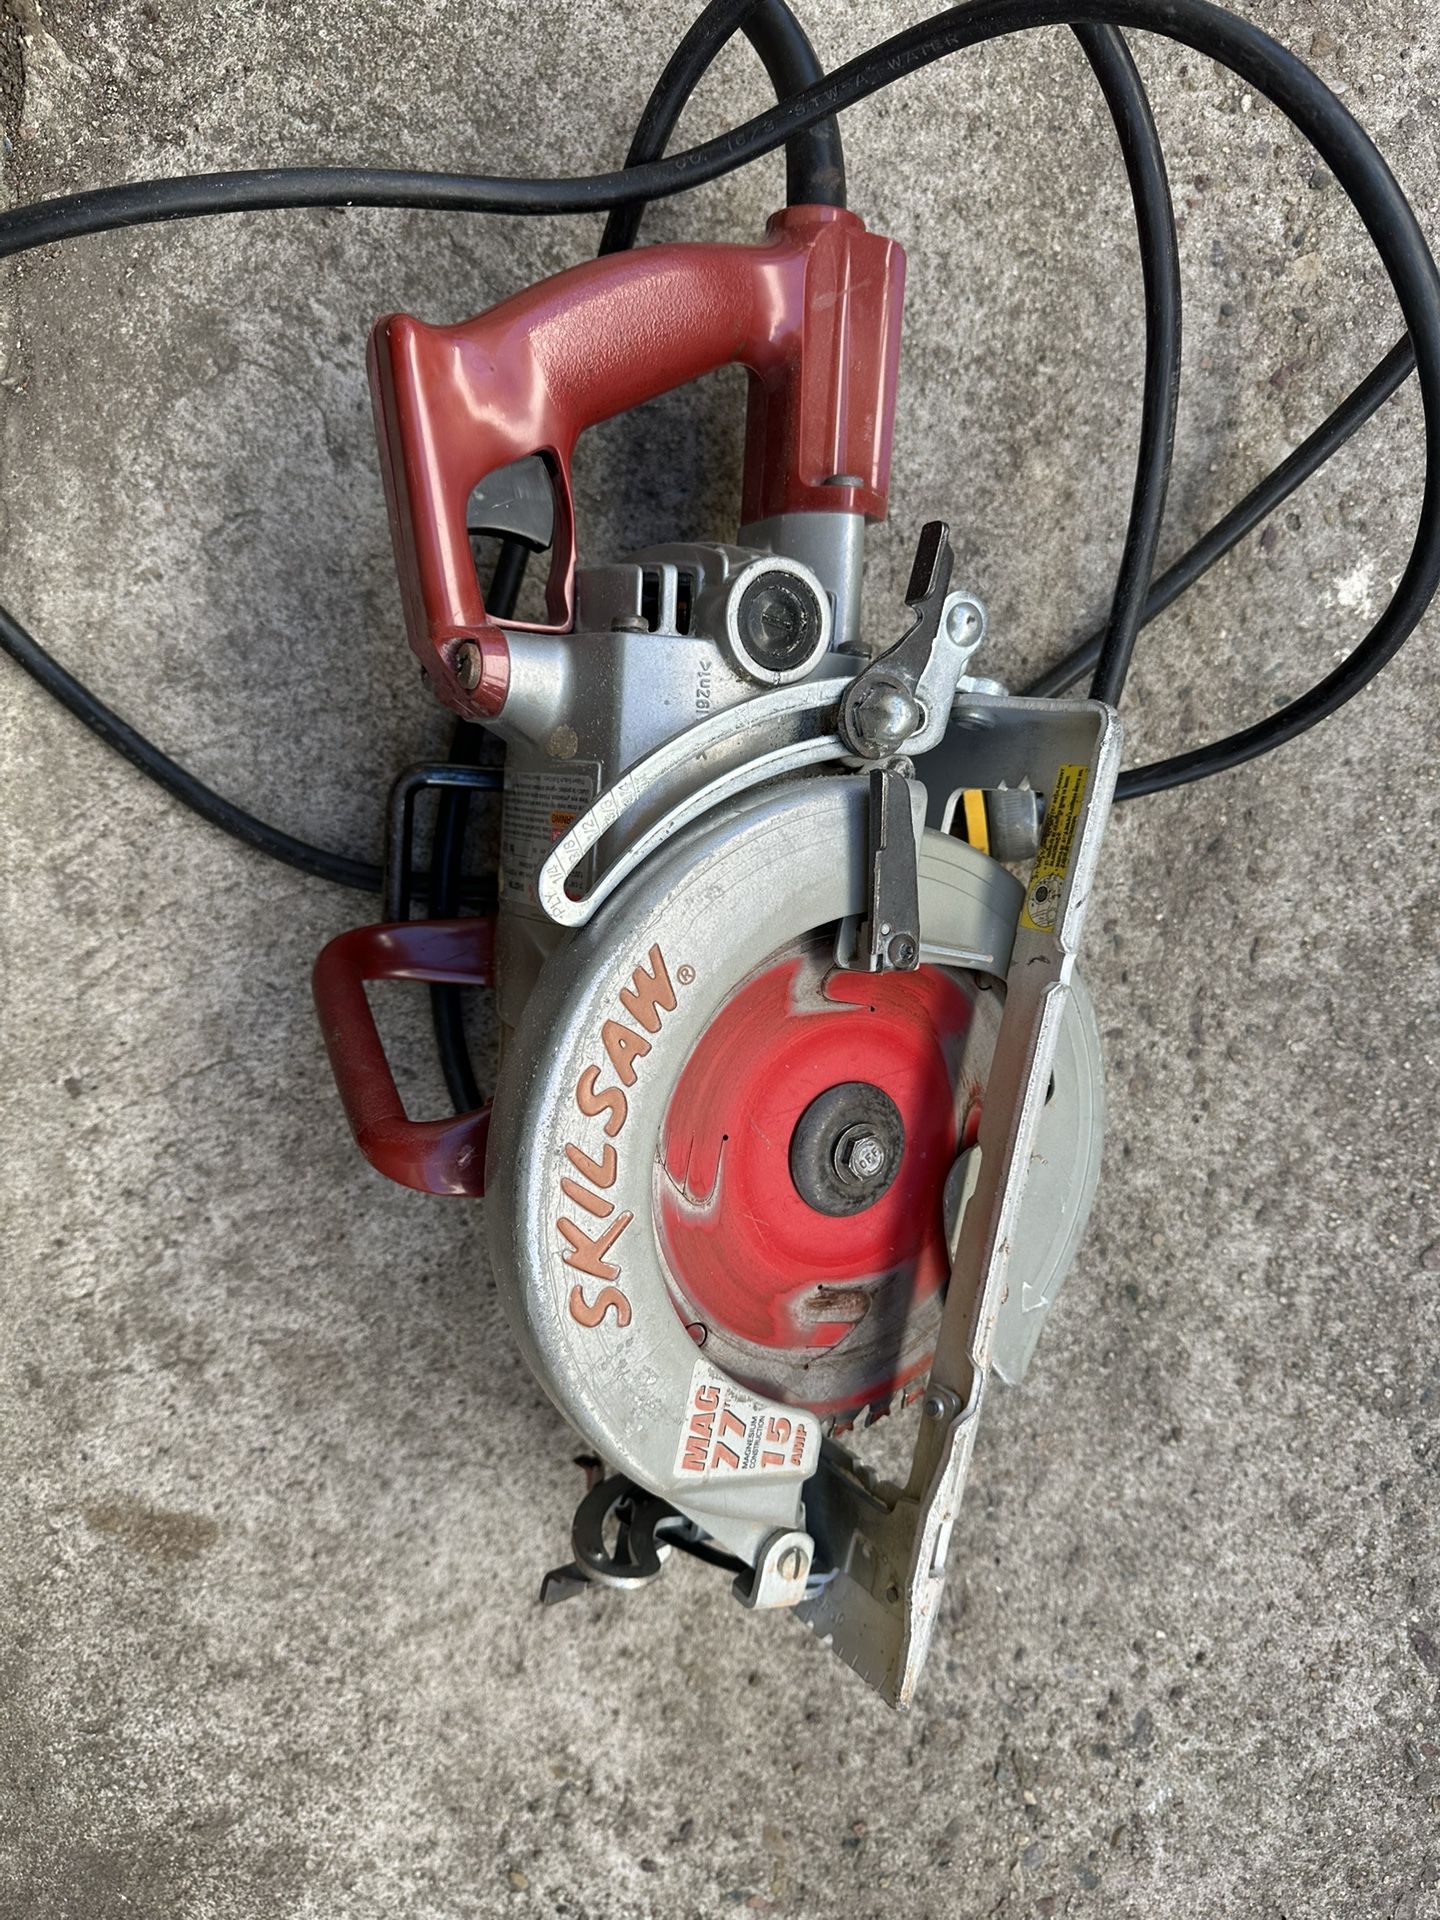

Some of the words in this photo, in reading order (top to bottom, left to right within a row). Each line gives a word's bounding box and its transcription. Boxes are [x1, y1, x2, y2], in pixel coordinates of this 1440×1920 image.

[557, 943, 677, 1328] SKILSAW
[682, 1384, 721, 1471] MAG
[742, 1416, 758, 1469] MAGNESIUM
[749, 1415, 766, 1469] CONSTRUCTION
[761, 1417, 792, 1468] 15
[791, 1423, 809, 1466] AMP
